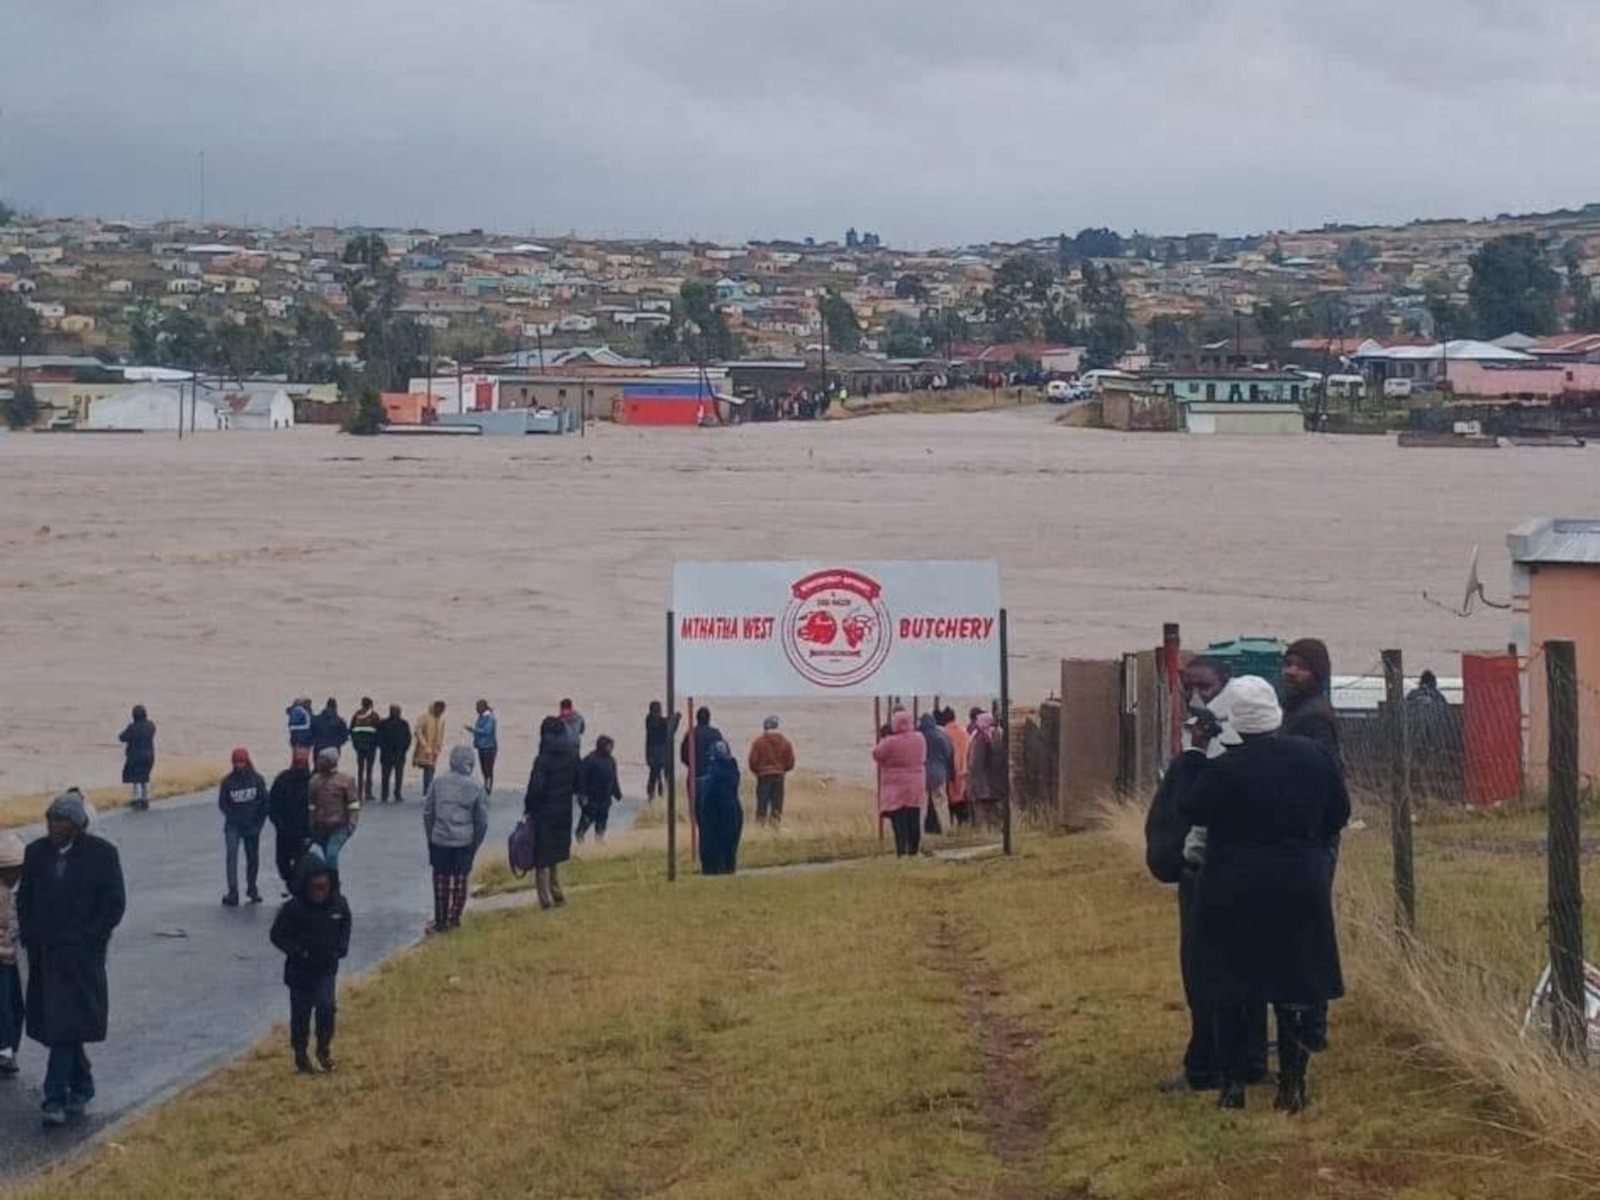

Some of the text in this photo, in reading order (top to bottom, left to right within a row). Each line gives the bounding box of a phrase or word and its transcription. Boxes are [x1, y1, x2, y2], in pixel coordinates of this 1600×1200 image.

[681, 616, 994, 640] MTHATHA WEST BUTCHERY
